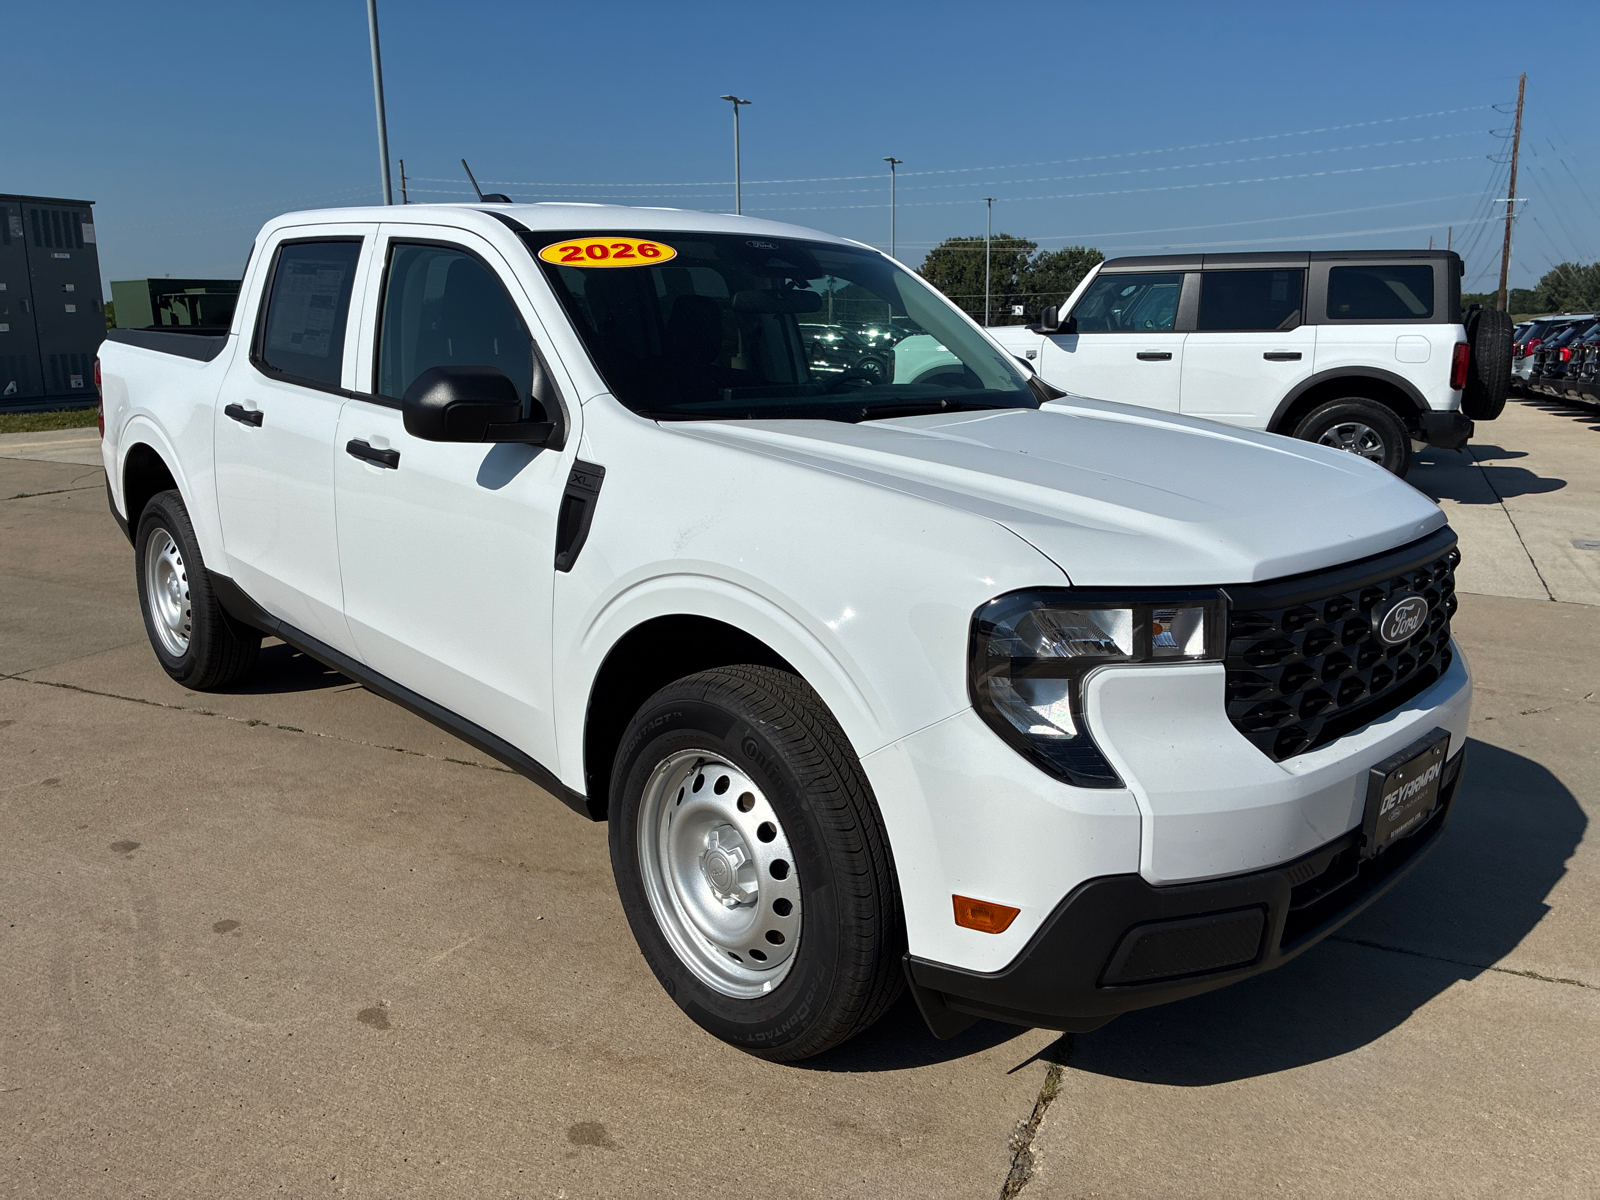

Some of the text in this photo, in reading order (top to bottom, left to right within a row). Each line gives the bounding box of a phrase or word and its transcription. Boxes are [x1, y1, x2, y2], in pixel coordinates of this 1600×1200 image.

[558, 243, 663, 262] 2026
[571, 473, 592, 488] XL
[1390, 603, 1420, 638] Ford
[612, 713, 671, 798] ROCONTACT
[1380, 760, 1443, 817] DEYARMAN
